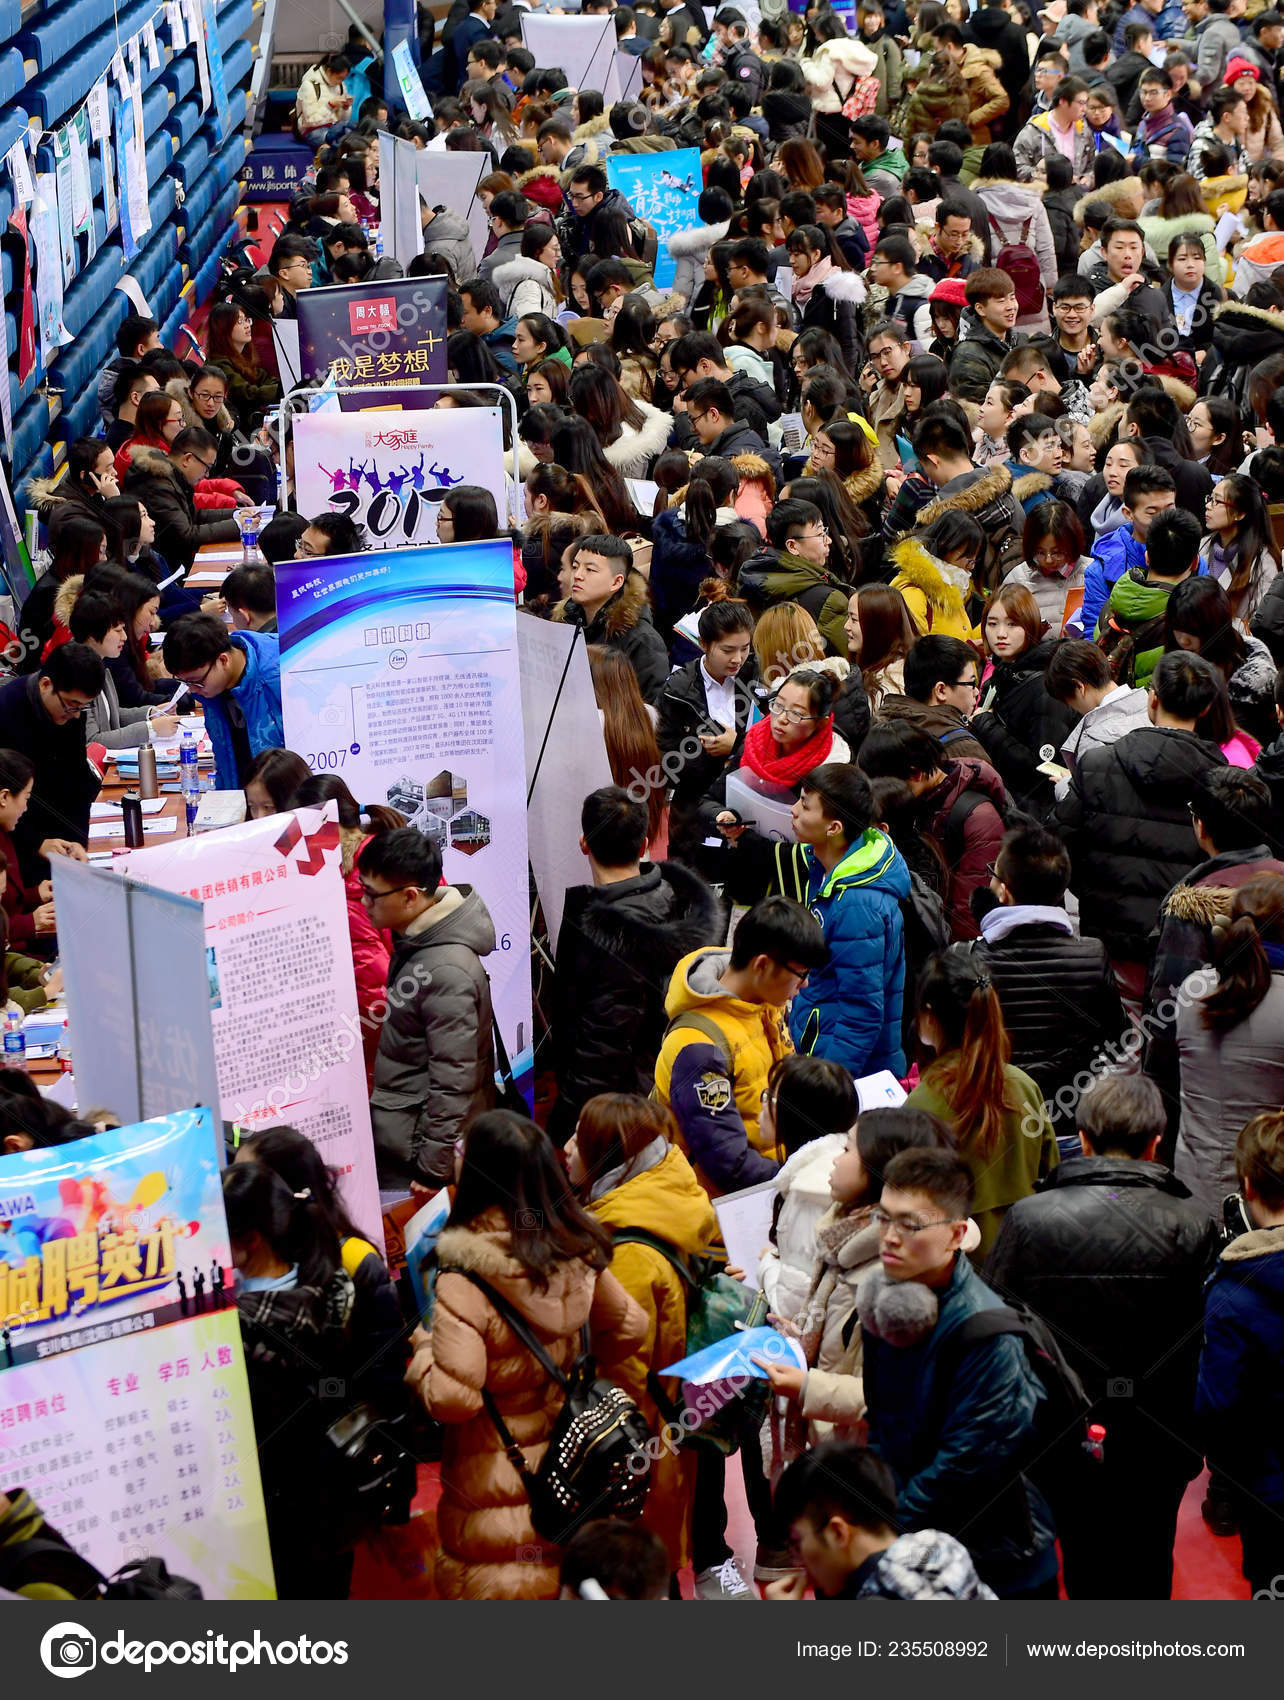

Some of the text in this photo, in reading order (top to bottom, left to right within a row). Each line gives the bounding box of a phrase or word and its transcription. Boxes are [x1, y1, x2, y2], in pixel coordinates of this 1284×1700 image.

[305, 750, 347, 771] 2007
[107, 1372, 140, 1397] 专业
[158, 1357, 191, 1383] 学历
[201, 1345, 233, 1371] 人数
